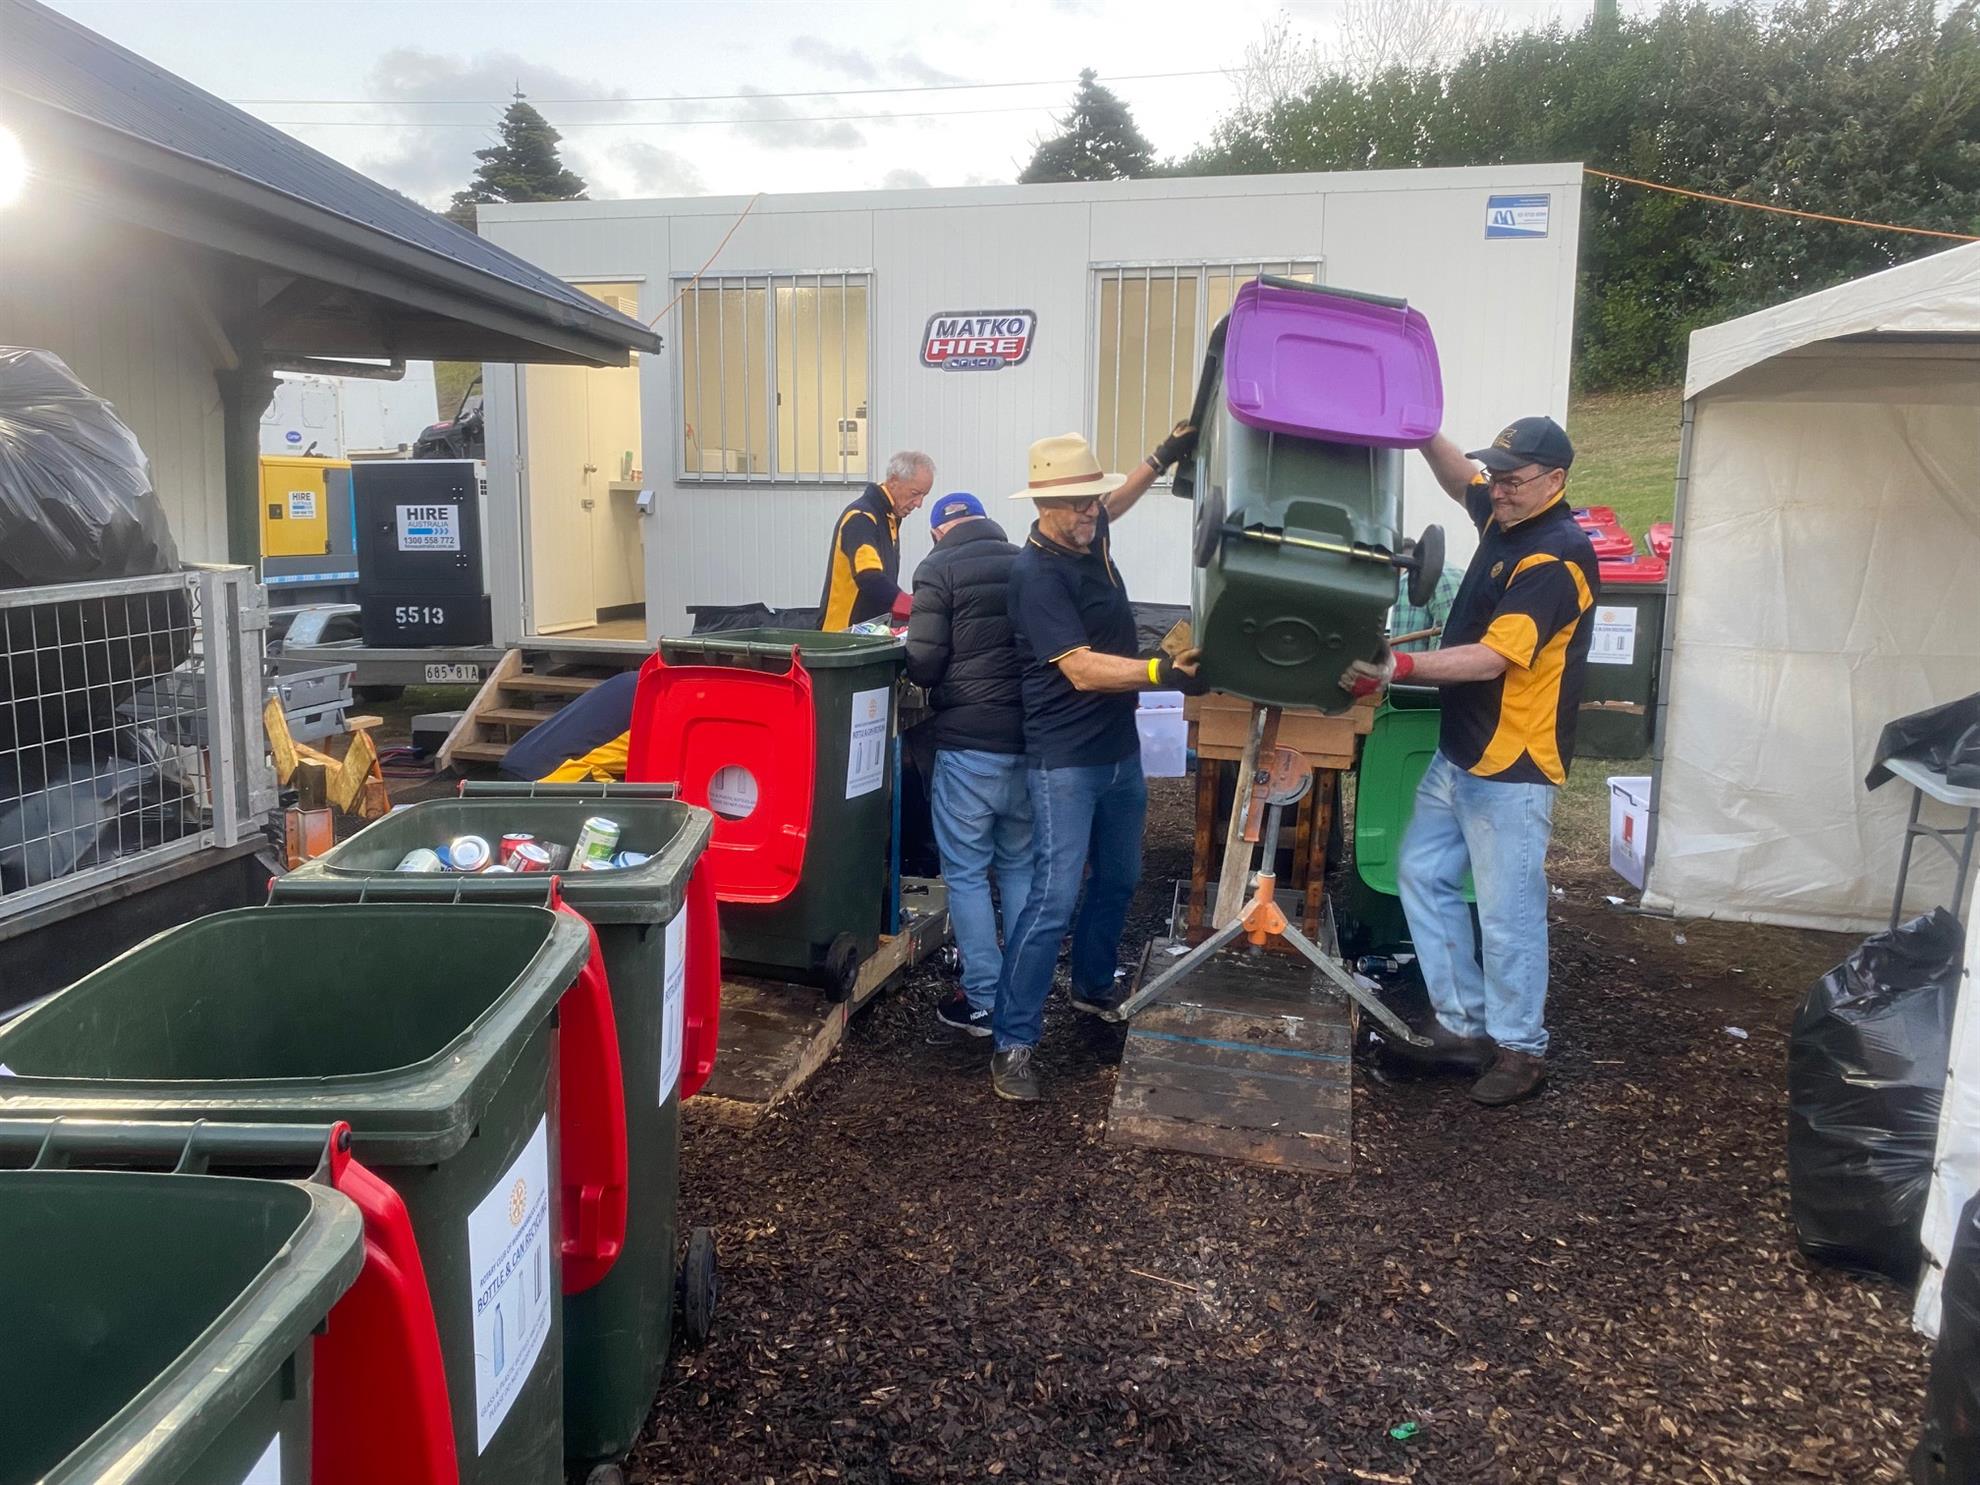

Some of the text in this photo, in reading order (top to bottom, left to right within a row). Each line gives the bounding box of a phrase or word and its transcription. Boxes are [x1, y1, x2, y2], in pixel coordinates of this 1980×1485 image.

[935, 318, 1026, 338] MATKO
[931, 339, 1019, 355] HIRE
[292, 492, 311, 501] HIRE
[407, 507, 448, 520] HIRE
[404, 536, 422, 544] 1300
[439, 536, 455, 544] 772
[395, 606, 444, 624] 5513
[427, 666, 447, 679] 685
[477, 1269, 505, 1313] BOTTLE
[505, 1260, 511, 1277] &
[512, 1241, 525, 1267] CAN
